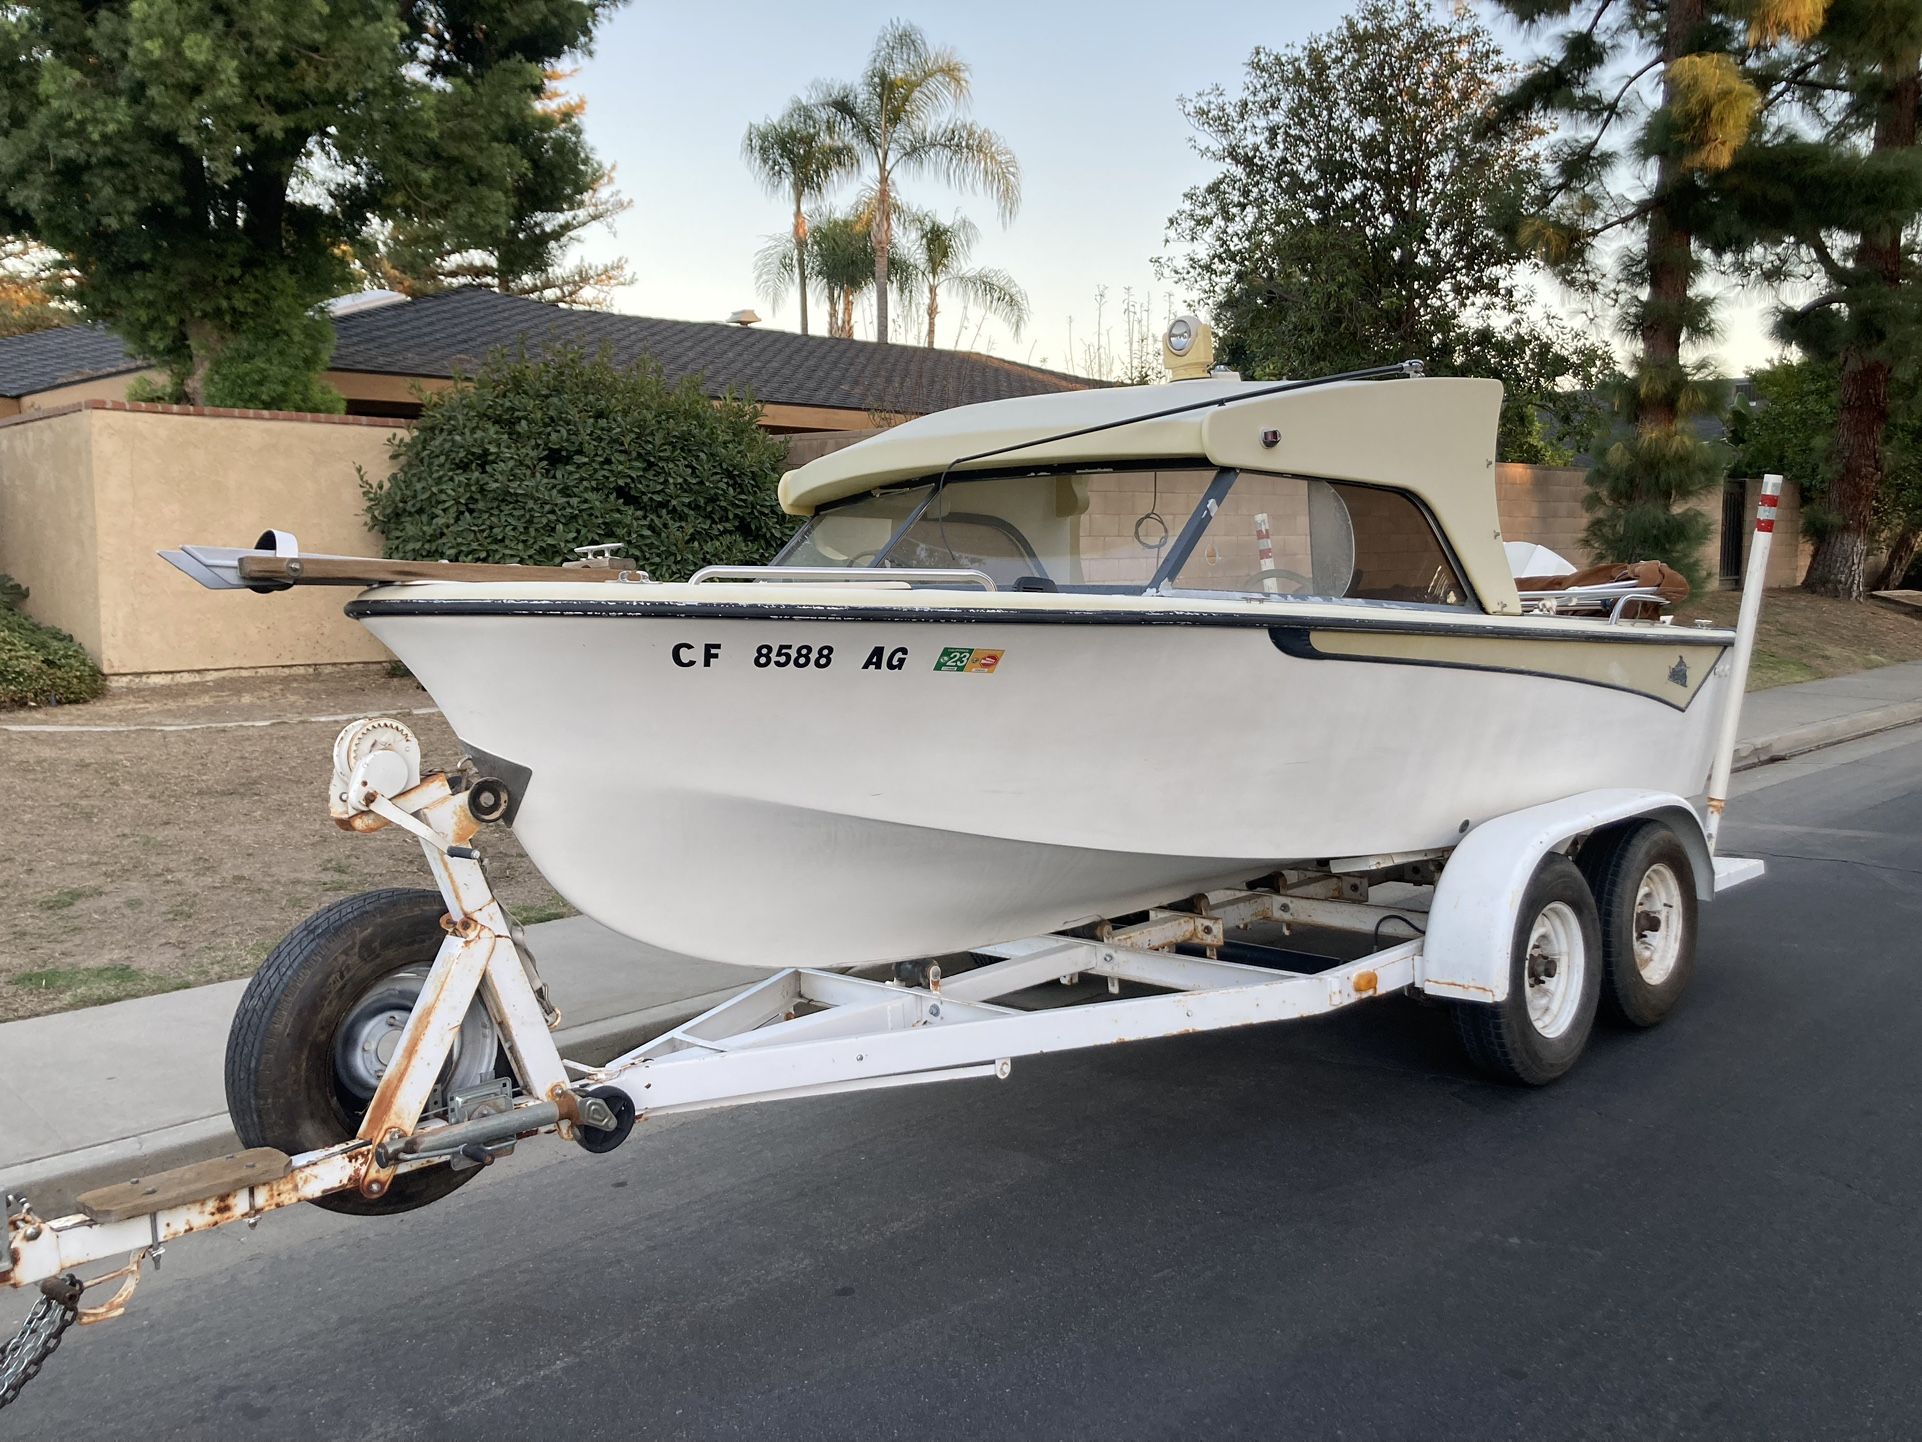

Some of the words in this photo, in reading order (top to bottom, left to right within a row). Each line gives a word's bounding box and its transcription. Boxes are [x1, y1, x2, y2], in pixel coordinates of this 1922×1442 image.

[671, 642, 722, 668] CF
[753, 643, 834, 669] 8588
[861, 645, 909, 671] AG
[946, 652, 970, 666] 23
